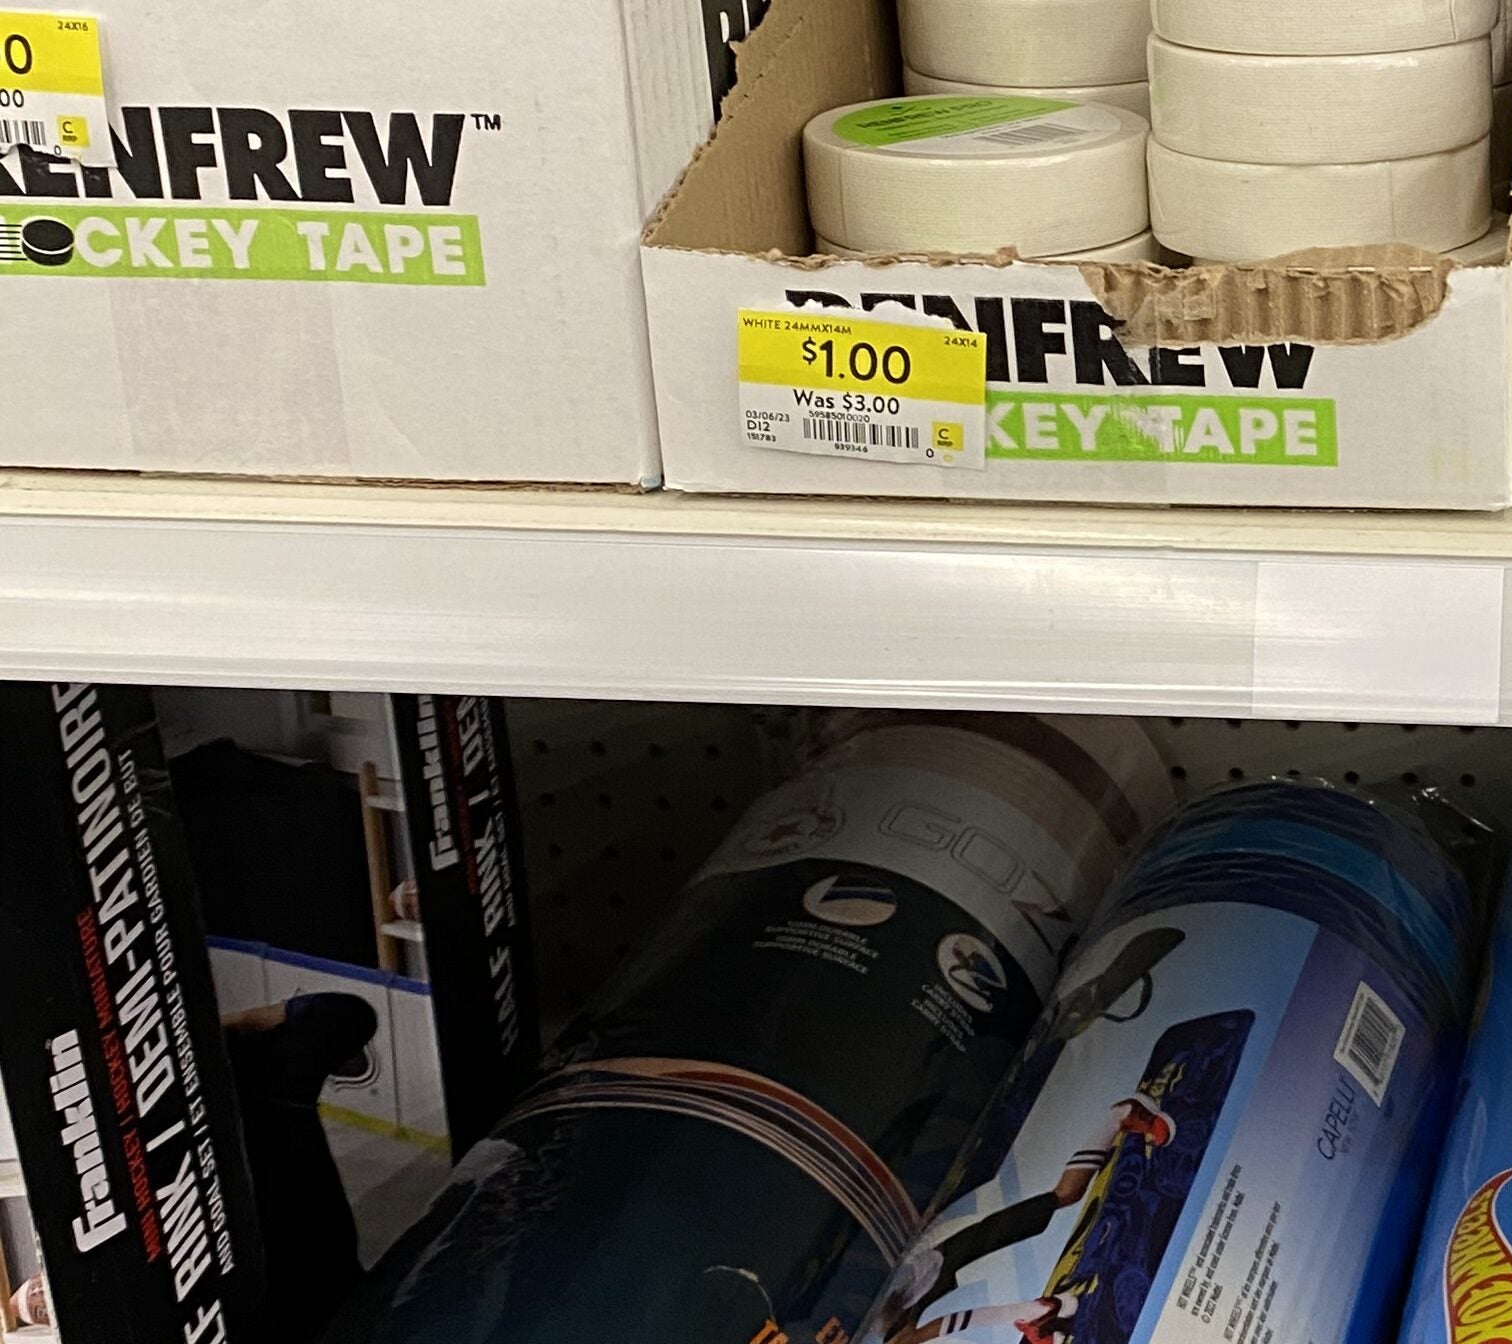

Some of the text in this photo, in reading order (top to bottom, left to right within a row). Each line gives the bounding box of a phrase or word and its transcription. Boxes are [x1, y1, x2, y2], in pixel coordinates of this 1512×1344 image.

[297, 222, 467, 275] TAPE
[743, 317, 781, 330] WHITE
[944, 336, 977, 348] 24X14
[802, 337, 911, 384] $1.00
[746, 411, 790, 422] 03/06/23
[793, 389, 900, 415] Was $3.00
[474, 817, 504, 937] RINK
[117, 749, 234, 1276] AND GOAL SET ET ENSEMBLE POUR GARDIEN DE BUT
[122, 1127, 152, 1212] HOCKEY
[157, 1150, 212, 1302] RINK
